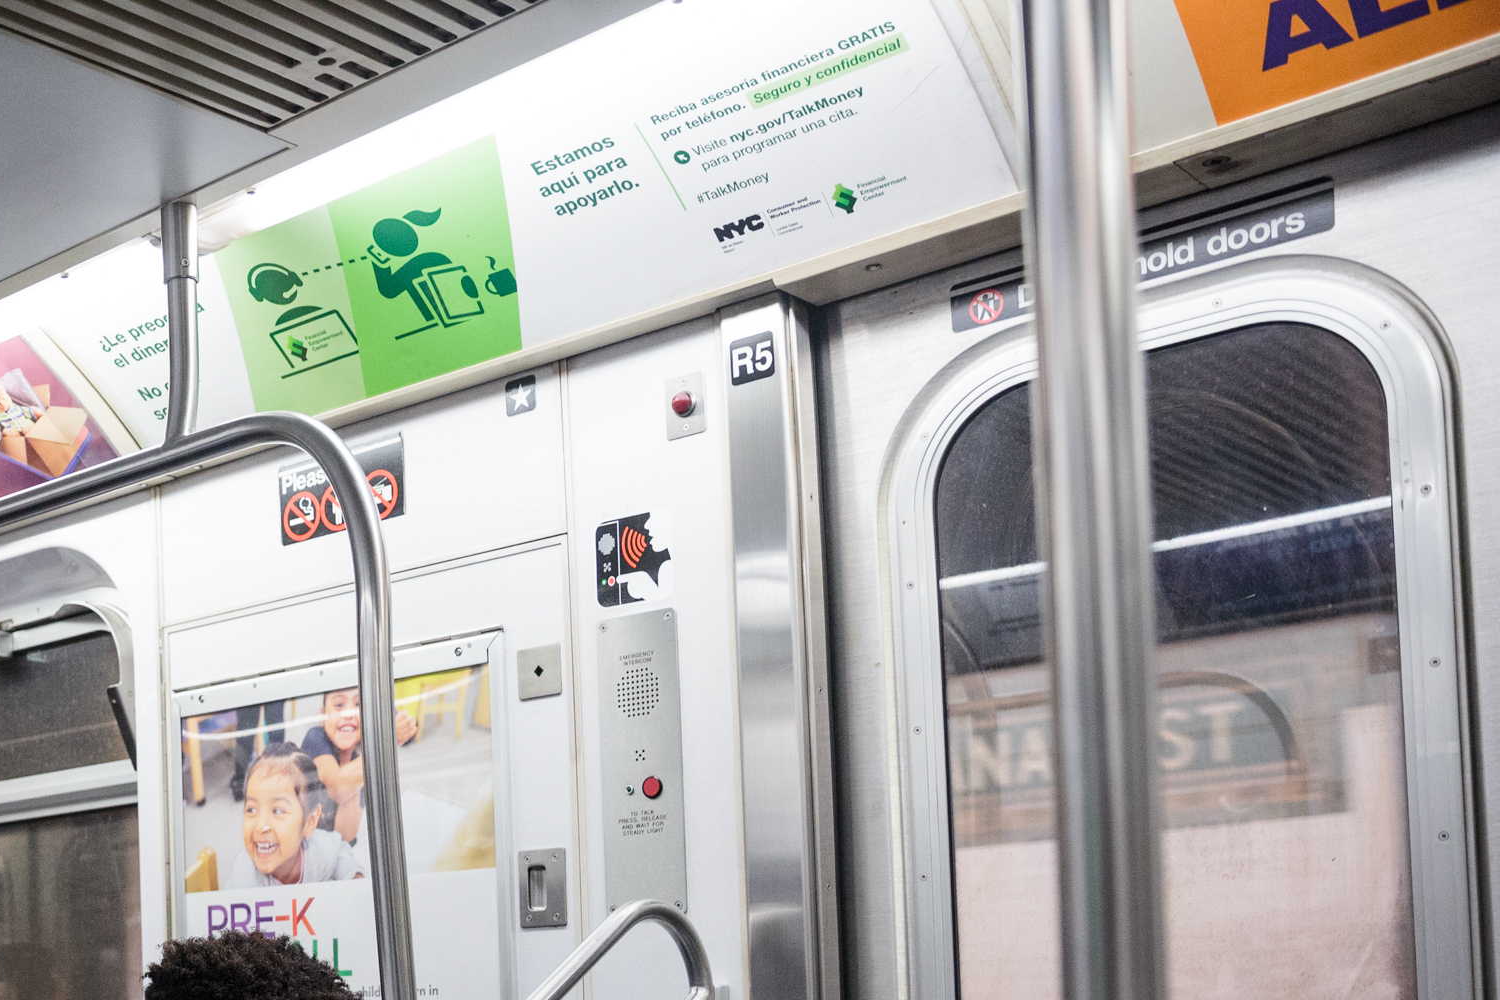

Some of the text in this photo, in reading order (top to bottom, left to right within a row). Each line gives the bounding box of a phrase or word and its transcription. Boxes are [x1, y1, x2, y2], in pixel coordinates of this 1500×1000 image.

[650, 21, 896, 125] Reciba asesoría financiera GRATIS
[660, 38, 902, 141] por teléfono. Seguro y confidencial
[691, 85, 864, 156] Visite nyc.gov/TalkMoney
[701, 107, 858, 172] para programar una cita.
[530, 137, 615, 176] Estamos
[539, 157, 628, 197] aquí para
[697, 172, 769, 204] #TalkMoney
[856, 175, 886, 189] Financial
[860, 175, 907, 195] Empowerment
[554, 180, 640, 216] apoyarlo.
[766, 196, 808, 214] Consumer and
[769, 199, 821, 219] Worker Protection
[862, 191, 884, 201] Center
[713, 213, 765, 242] NYC
[1207, 212, 1306, 256] doors
[99, 334, 127, 353] ¿Le
[114, 339, 169, 368] el diner
[732, 340, 773, 379] R5
[137, 386, 162, 401] No
[619, 650, 654, 660] EMERGENCY
[623, 657, 651, 666] INTERCOM
[207, 897, 316, 938] PRE-K
